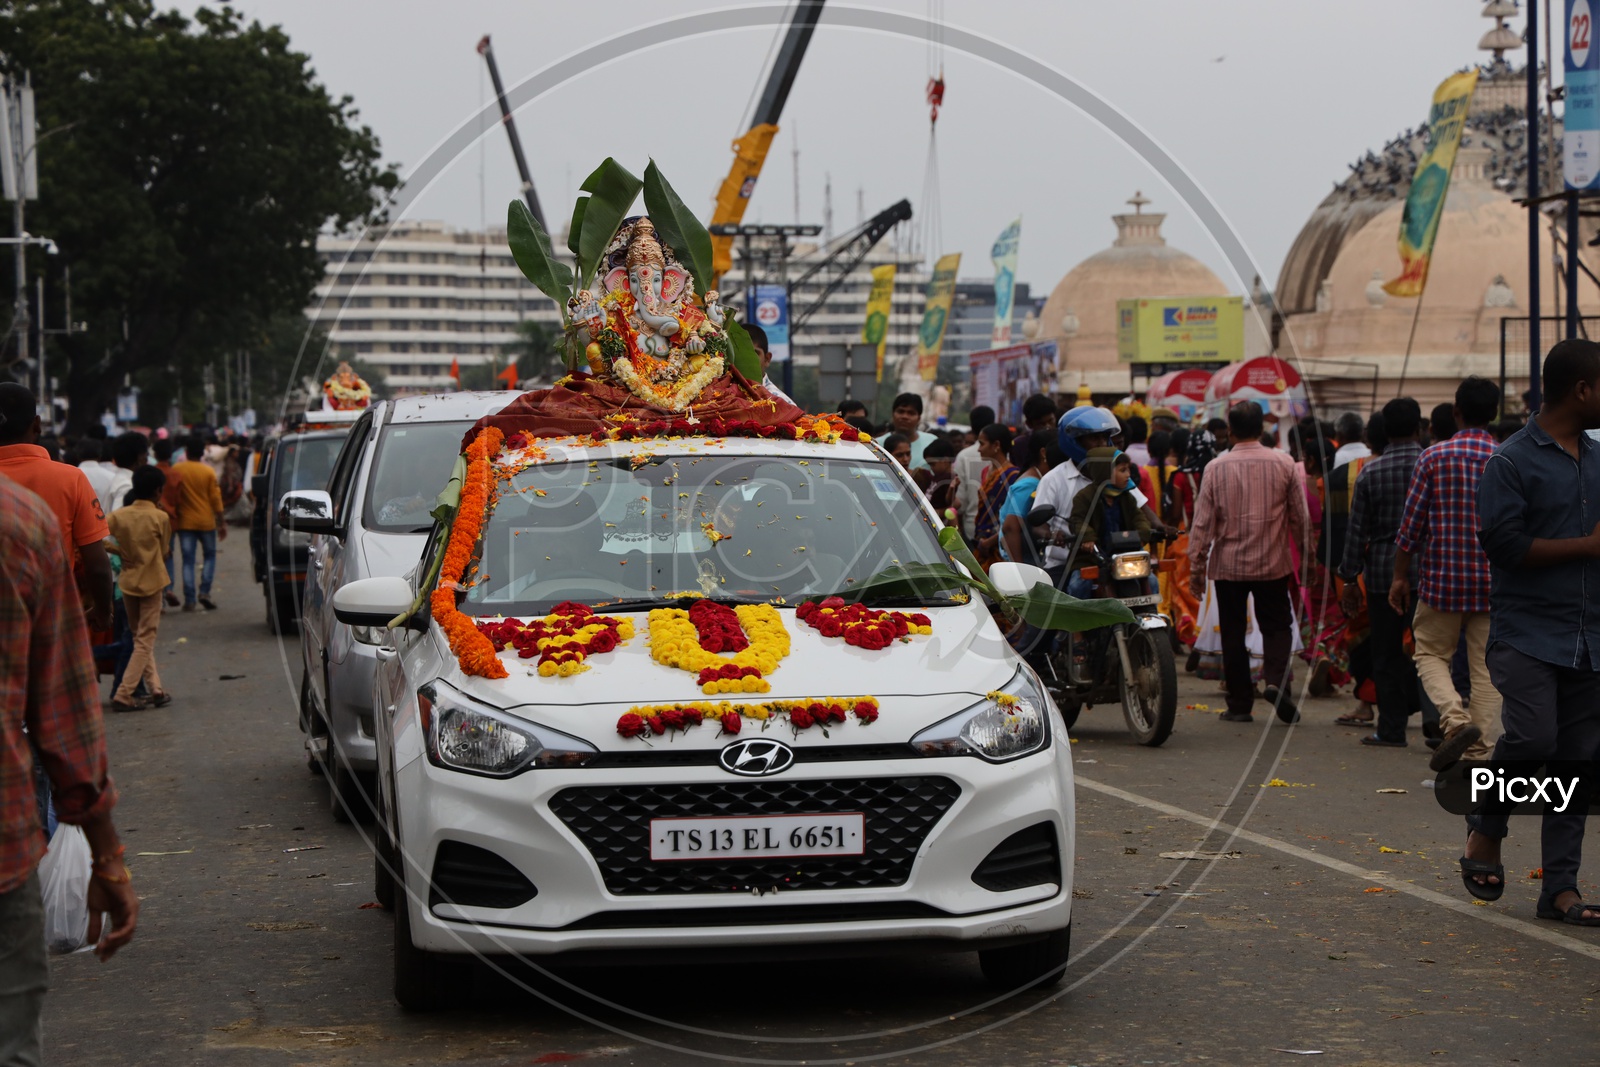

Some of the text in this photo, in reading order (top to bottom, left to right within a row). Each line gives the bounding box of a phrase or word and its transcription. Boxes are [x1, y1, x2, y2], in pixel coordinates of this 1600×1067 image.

[1571, 14, 1590, 50] 22
[759, 306, 779, 320] 23
[743, 827, 780, 850] EL
[789, 825, 845, 849] 6651
